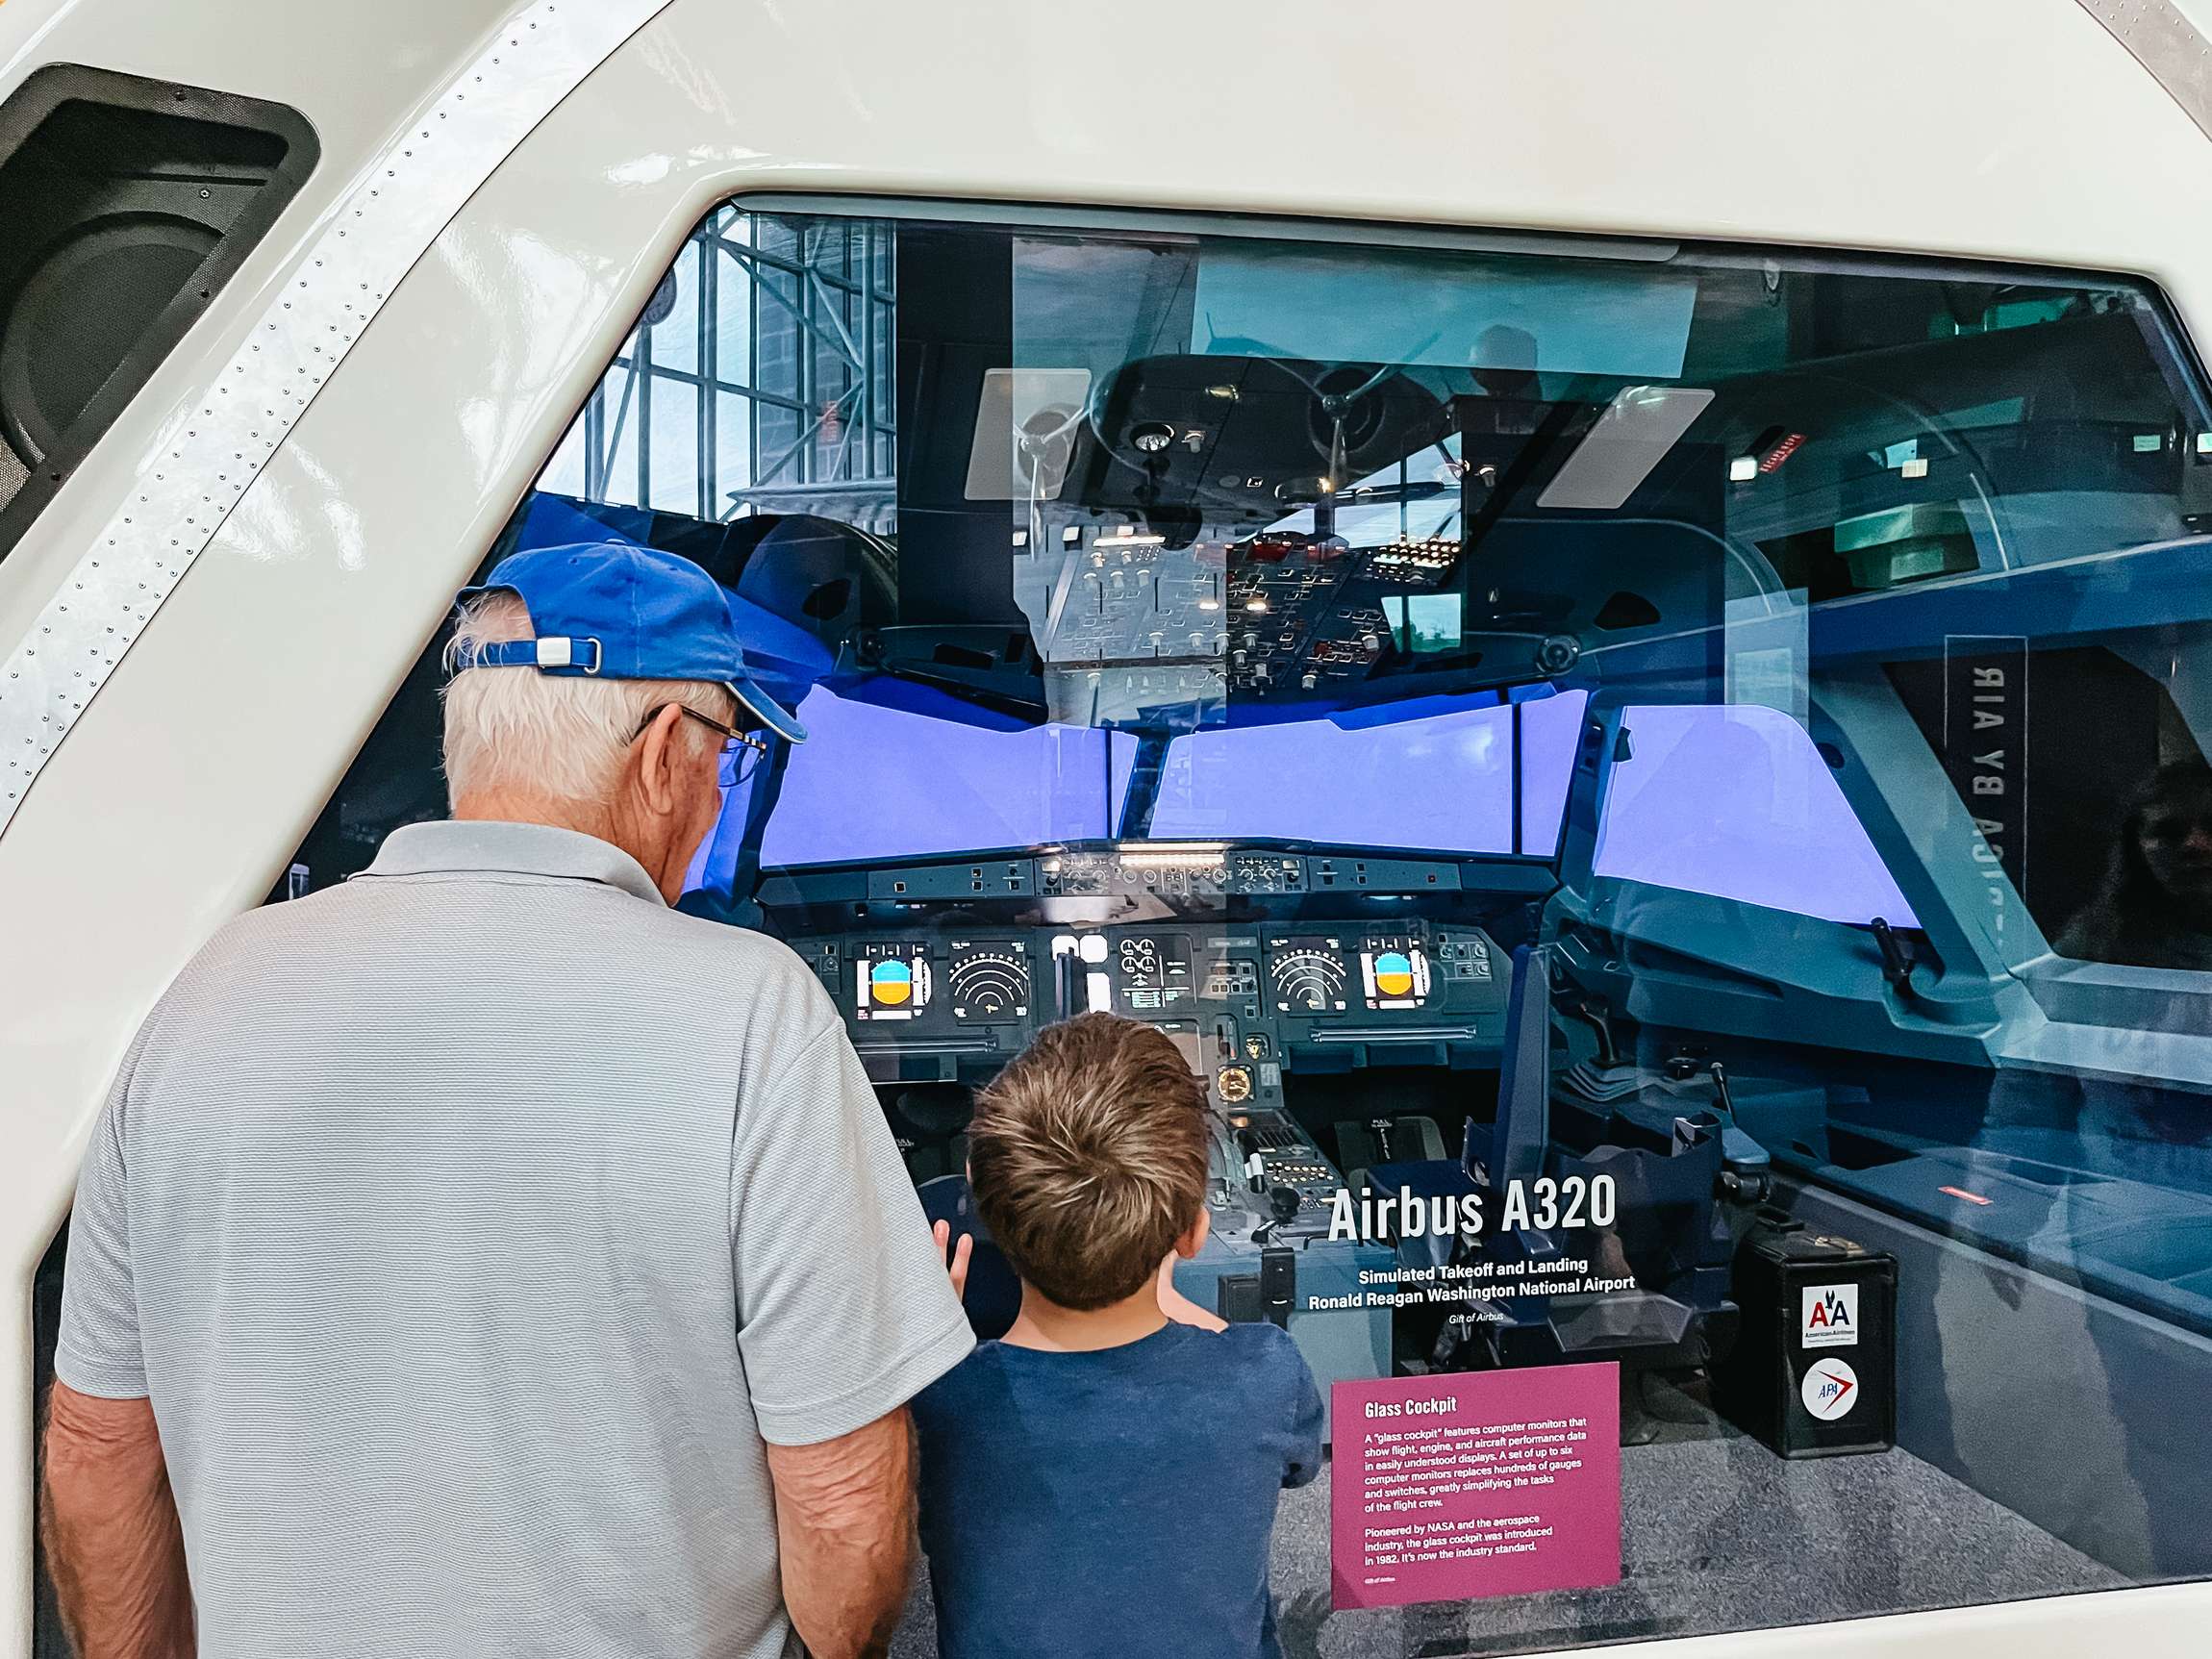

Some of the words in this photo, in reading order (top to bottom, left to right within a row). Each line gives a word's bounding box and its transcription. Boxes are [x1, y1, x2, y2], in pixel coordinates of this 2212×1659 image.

[1328, 1185, 1483, 1242] Airbus
[1501, 1174, 1617, 1232] A320
[1358, 1266, 1435, 1285] Simulated
[1439, 1263, 1493, 1280] Takeoff
[1496, 1261, 1524, 1276] and
[1528, 1258, 1588, 1275] Landing
[1309, 1292, 1363, 1310] Ronald
[1366, 1289, 1423, 1310] Reagan
[1427, 1283, 1516, 1303] Washington
[1519, 1280, 1580, 1296] National
[1584, 1275, 1635, 1295] Airport
[1449, 1315, 1465, 1323] Gift
[1466, 1313, 1476, 1322] of
[1476, 1312, 1504, 1321] Airbus
[1818, 1383, 1838, 1399] APA
[1365, 1401, 1401, 1419] Glass
[1406, 1396, 1456, 1416] Cockpit
[1365, 1435, 1372, 1444] A
[1444, 1425, 1481, 1437] features
[1483, 1422, 1525, 1435] computer
[1528, 1420, 1568, 1430] monitors
[1569, 1417, 1587, 1427] that
[1365, 1446, 1390, 1458] show
[1392, 1444, 1418, 1456] flight,
[1420, 1442, 1453, 1454] engine,
[1455, 1440, 1473, 1451] and
[1475, 1437, 1507, 1448] aircraft
[1509, 1433, 1566, 1447] performance
[1567, 1431, 1587, 1441] data
[1365, 1461, 1373, 1471] in
[1376, 1459, 1402, 1471] easily
[1404, 1454, 1456, 1469] understood
[1458, 1451, 1497, 1464] displays.
[1499, 1451, 1506, 1460] A
[1508, 1448, 1522, 1459] set
[1523, 1447, 1534, 1457] of
[1535, 1448, 1547, 1459] up
[1549, 1447, 1559, 1456] to
[1560, 1445, 1572, 1455] six
[1365, 1474, 1409, 1486] computer
[1411, 1470, 1452, 1482] monitors
[1454, 1466, 1492, 1479] replaces
[1494, 1462, 1537, 1473] hundreds
[1538, 1461, 1548, 1470] of
[1549, 1459, 1582, 1472] gauges
[1365, 1488, 1383, 1499] and
[1385, 1485, 1428, 1497] switches,
[1430, 1482, 1460, 1496] greatly
[1463, 1478, 1512, 1492] simplifying
[1514, 1476, 1529, 1487] the
[1530, 1473, 1554, 1485] tasks
[1365, 1503, 1375, 1513] of
[1376, 1502, 1392, 1512] the
[1394, 1499, 1417, 1512] flight
[1419, 1498, 1443, 1508] crew.
[1365, 1526, 1412, 1538] Pioneered
[1414, 1524, 1425, 1537] by
[1427, 1521, 1455, 1532] NASA
[1457, 1520, 1474, 1530] and
[1476, 1517, 1492, 1528] the
[1494, 1515, 1539, 1528] aerospace
[1365, 1541, 1405, 1553] industry,
[1406, 1538, 1421, 1549] the
[1423, 1536, 1447, 1549] glass
[1449, 1532, 1483, 1546] cockpit
[1485, 1531, 1502, 1541] was
[1504, 1526, 1552, 1538] introduced
[1365, 1555, 1373, 1566] in
[1375, 1554, 1399, 1565] 1982.
[1401, 1552, 1416, 1563] It's
[1418, 1551, 1437, 1562] now
[1439, 1548, 1454, 1559] the
[1456, 1545, 1493, 1559] industry
[1495, 1542, 1537, 1554] standard.
